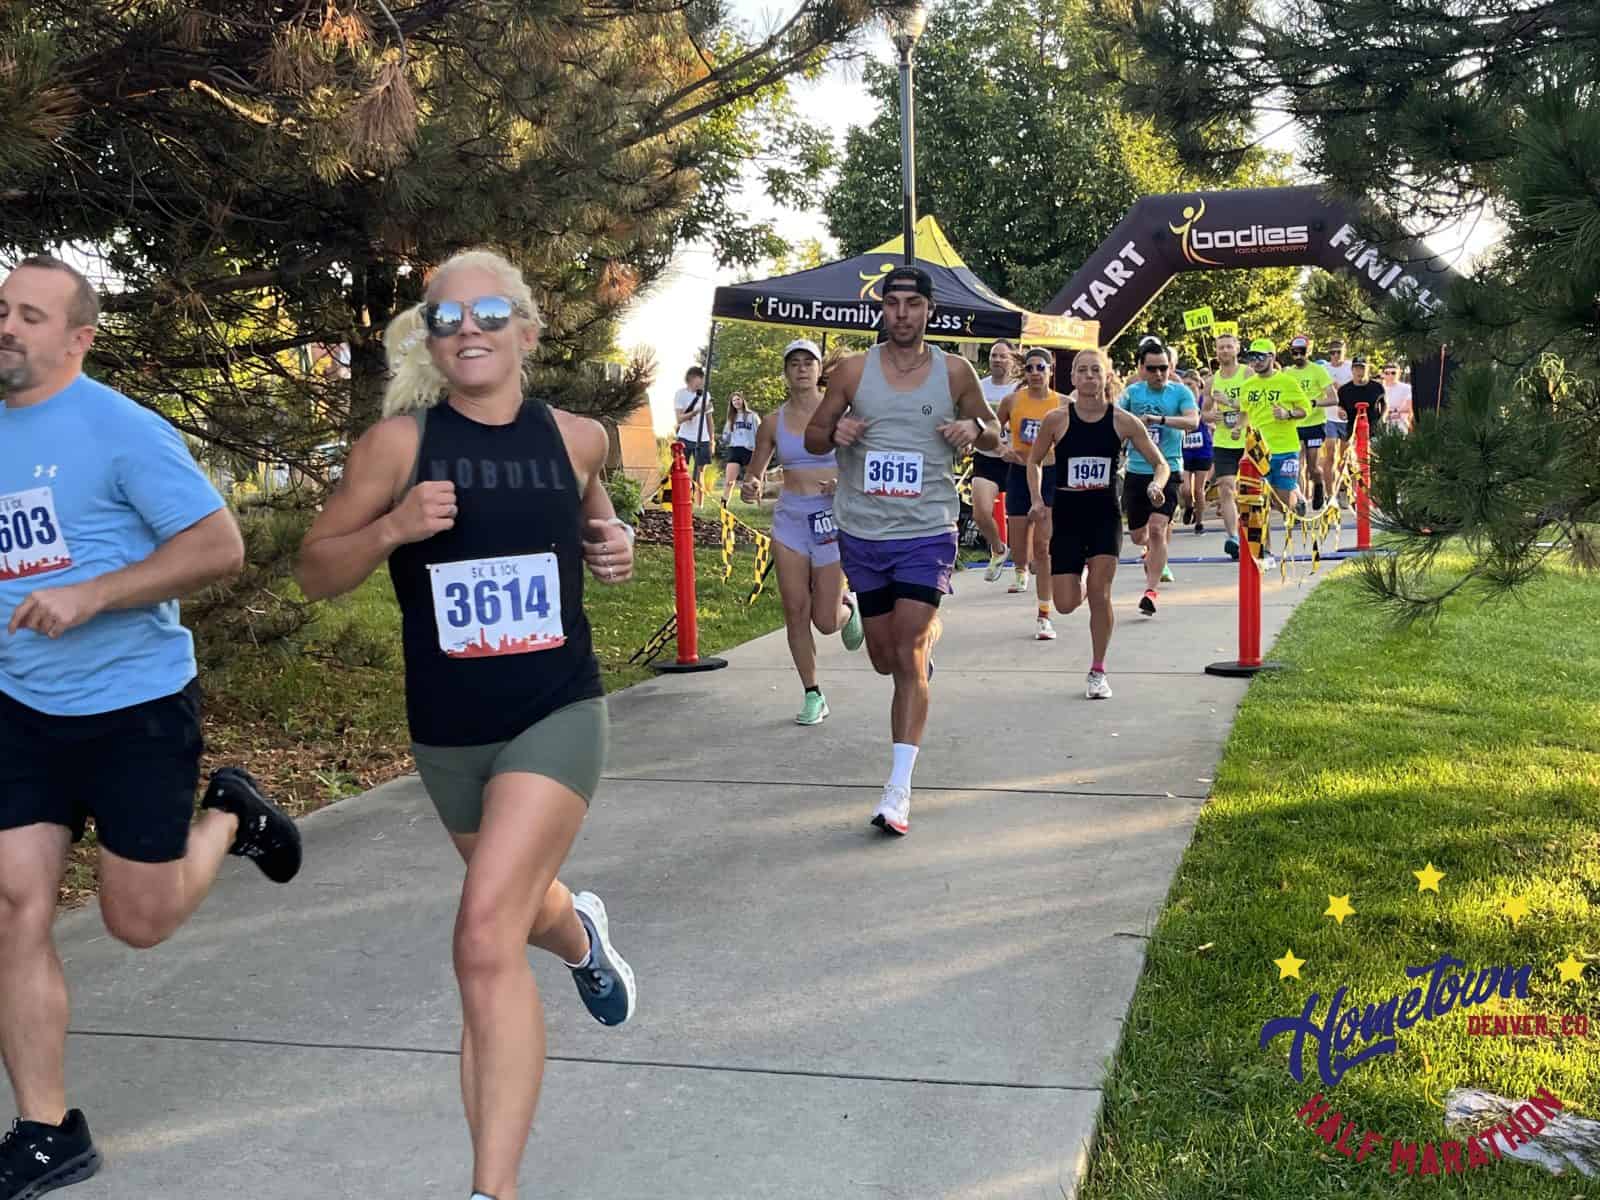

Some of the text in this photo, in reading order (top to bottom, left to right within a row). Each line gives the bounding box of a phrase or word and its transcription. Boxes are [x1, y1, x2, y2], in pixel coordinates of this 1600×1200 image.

[1191, 224, 1309, 249] bodies
[1063, 240, 1145, 319] TART
[430, 457, 567, 490] NOBULL
[868, 459, 918, 484] 3615
[1073, 463, 1106, 480] 1947
[445, 574, 550, 628] 3614
